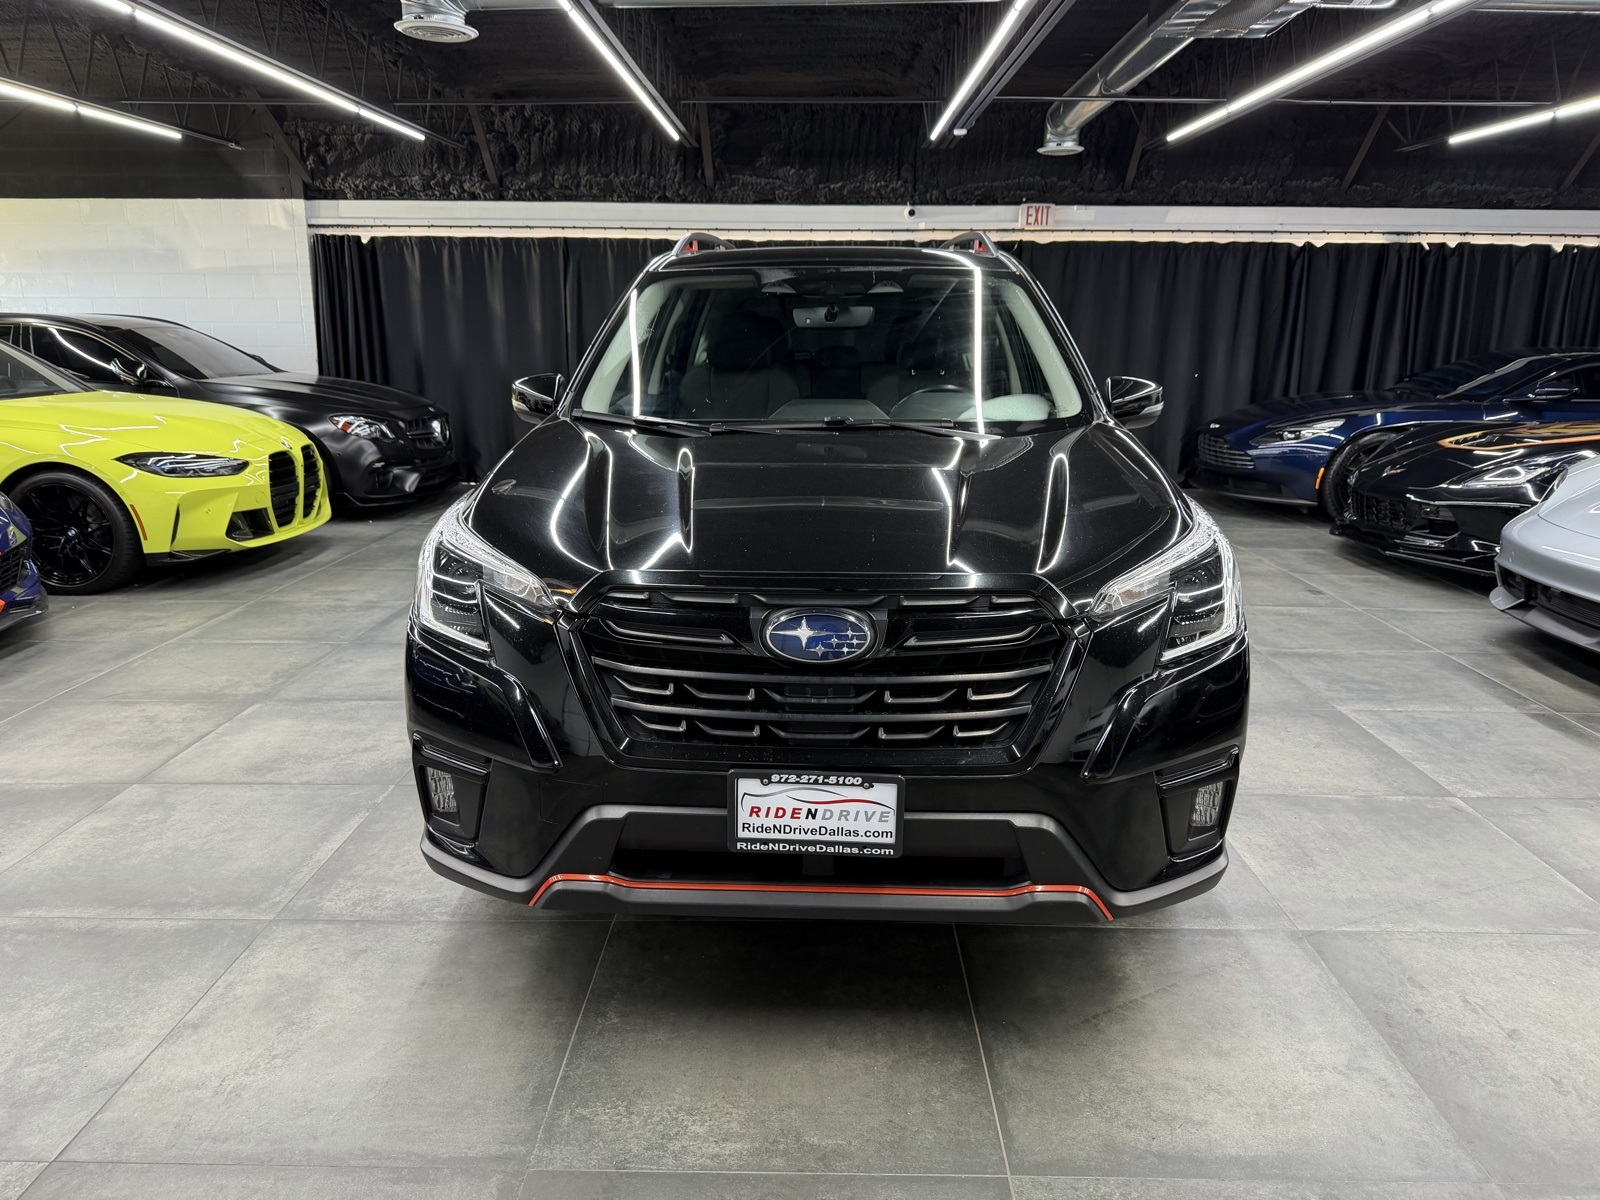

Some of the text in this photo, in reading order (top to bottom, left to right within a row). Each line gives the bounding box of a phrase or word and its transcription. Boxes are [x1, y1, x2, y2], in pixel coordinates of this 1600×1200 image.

[1026, 205, 1051, 225] EXIT
[771, 774, 862, 785] 972-271-5100
[749, 805, 890, 823] RIDENDRIVE
[742, 822, 893, 839] RideNDriveDallas.com
[737, 842, 894, 855] RideNDriveDallas.com
